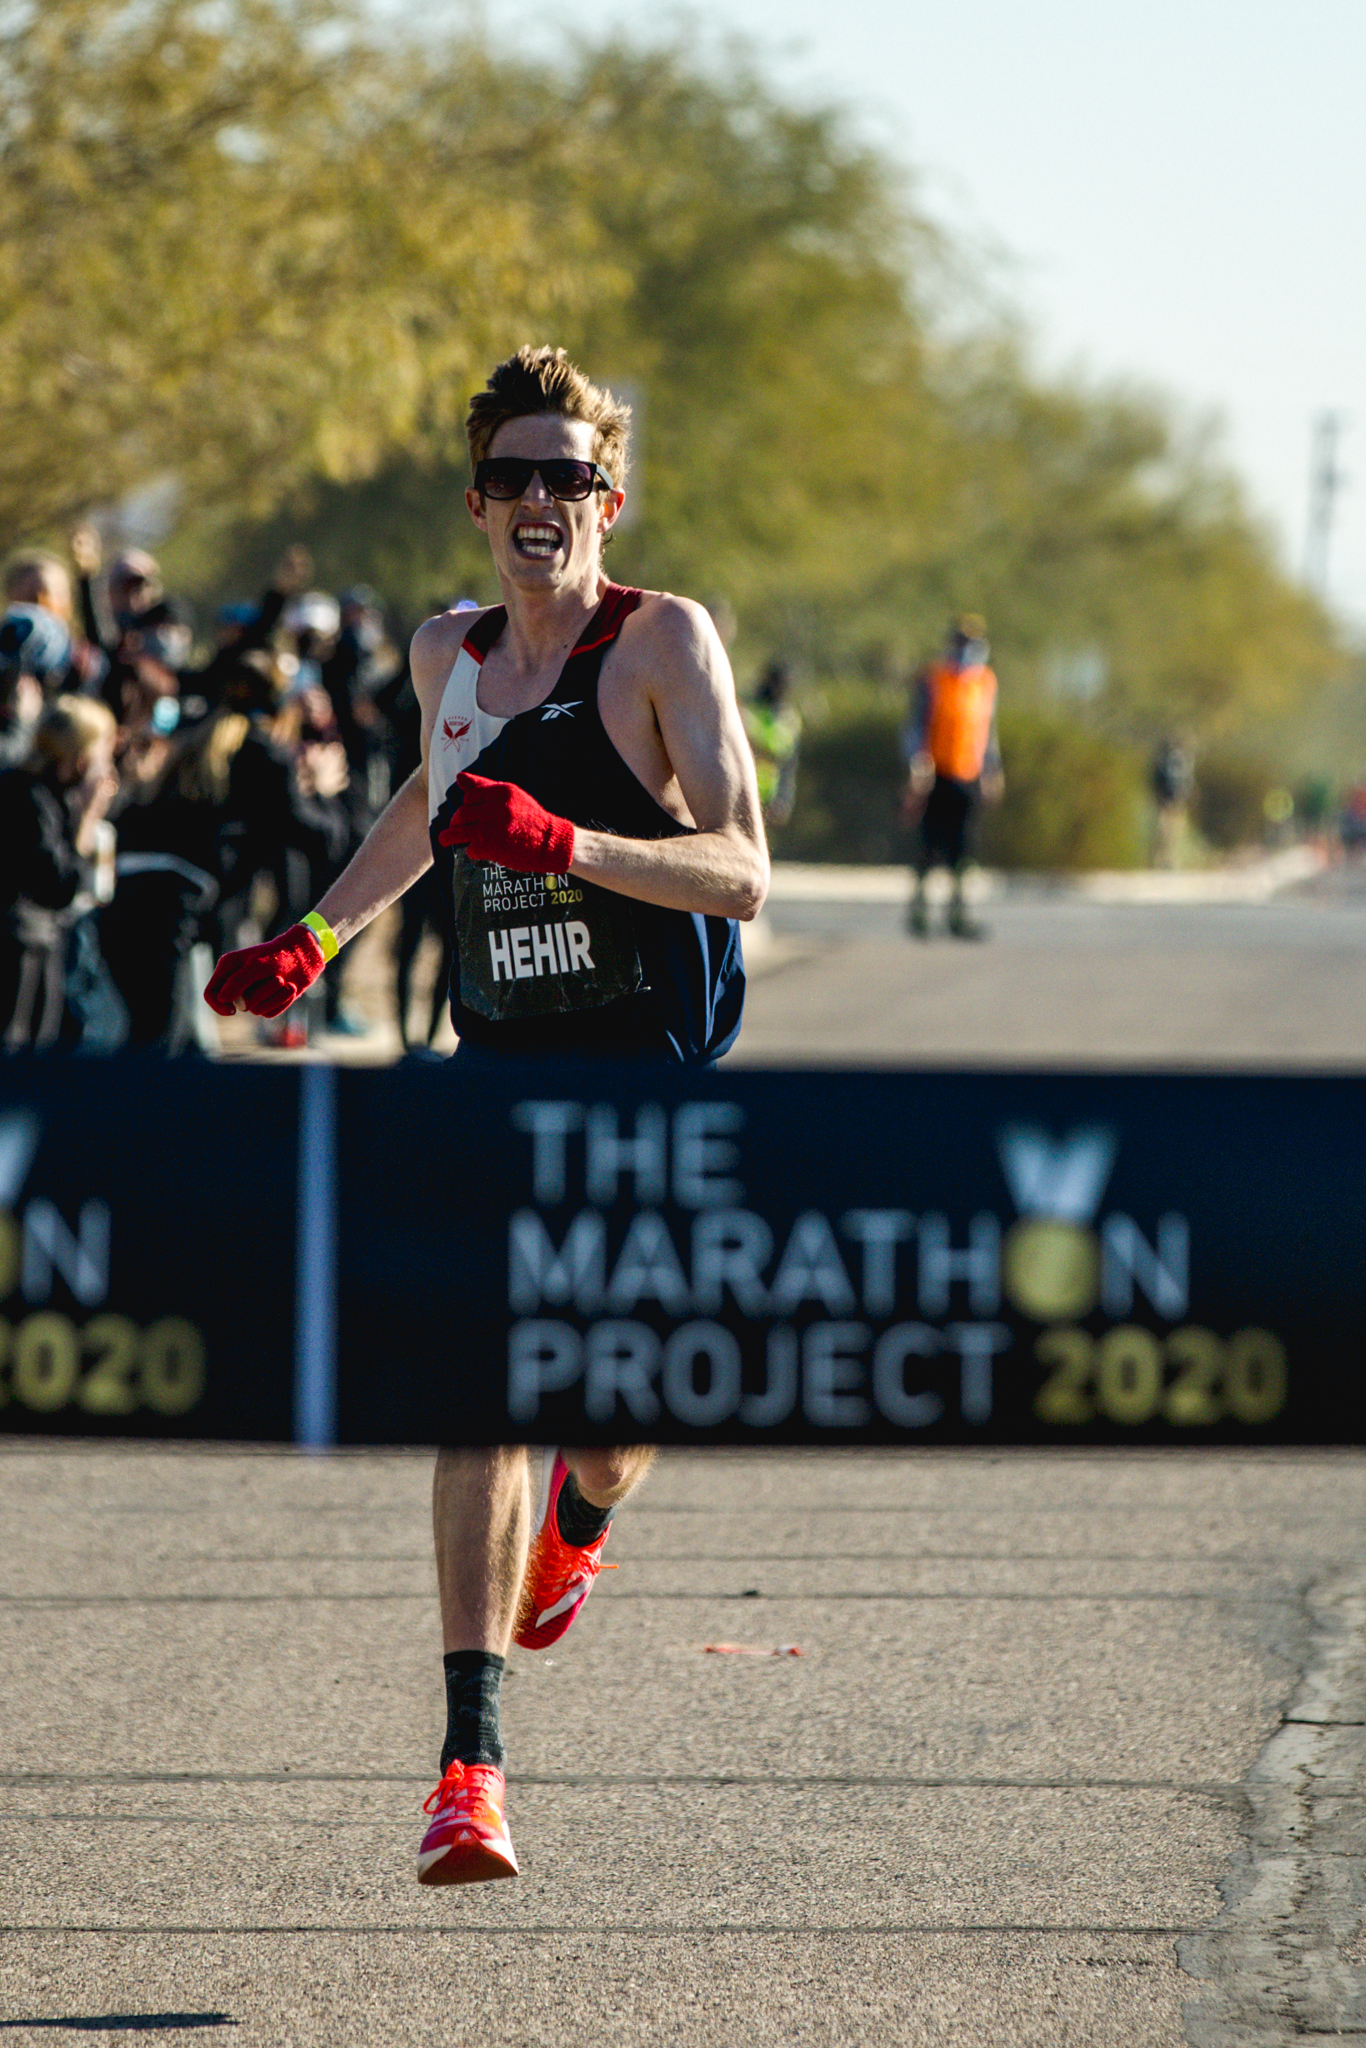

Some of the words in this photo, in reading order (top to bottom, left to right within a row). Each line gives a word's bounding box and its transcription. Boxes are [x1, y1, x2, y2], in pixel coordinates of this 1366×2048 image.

[482, 865, 508, 881] THE
[482, 874, 569, 897] MARATHON
[484, 892, 547, 913] PROJECT
[551, 889, 583, 905] 2020
[488, 920, 596, 982] HEHIR
[512, 1100, 746, 1208] THE
[508, 1207, 1190, 1318] MARATHON
[0, 1311, 204, 1415] 020
[508, 1317, 1012, 1428] PROJECT
[1033, 1323, 1288, 1426] 2020
